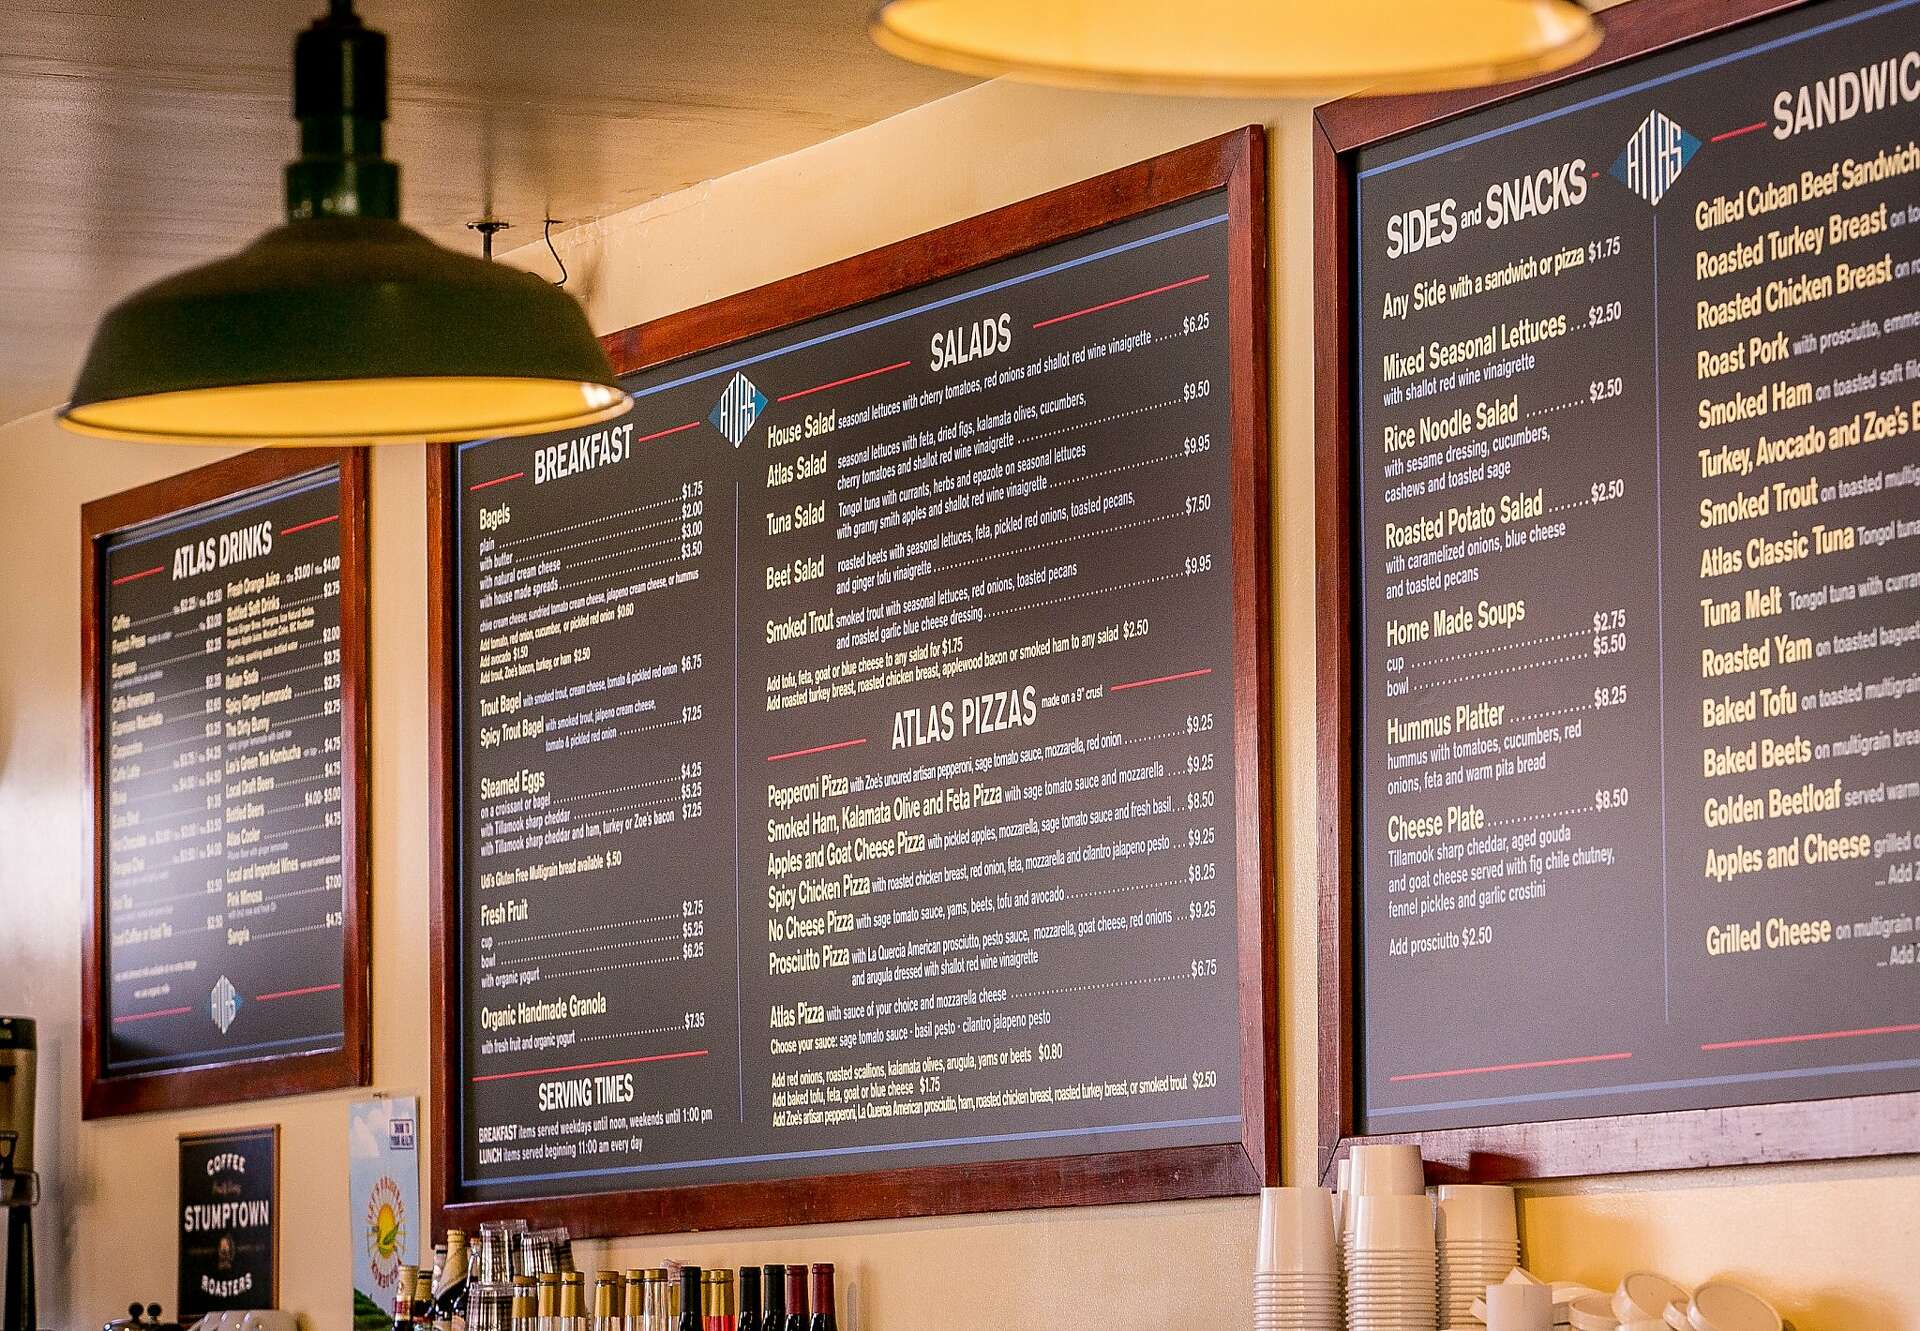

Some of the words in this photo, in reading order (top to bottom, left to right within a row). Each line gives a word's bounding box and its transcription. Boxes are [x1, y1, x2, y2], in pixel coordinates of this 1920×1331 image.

[1626, 108, 1682, 205] ATLAS
[1386, 198, 1458, 259] SIDES
[1460, 201, 1482, 230] and
[1485, 158, 1588, 230] SNACKS
[1695, 190, 1744, 231] Grilled
[1746, 182, 1798, 217] Cuban
[1801, 162, 1839, 202] Beef
[1696, 235, 1764, 281] Roasted
[1767, 225, 1825, 261] Turkey
[1828, 202, 1888, 245] Breast
[1382, 292, 1409, 321] Any
[1413, 278, 1447, 311] Side
[1449, 274, 1473, 301] with
[1474, 276, 1483, 294] a
[1484, 255, 1538, 291] sandwich
[1539, 255, 1553, 276] or
[1554, 246, 1585, 277] pizza
[1588, 235, 1621, 264] $1.75
[930, 312, 1012, 372] SALADS
[1383, 345, 1425, 382] Mixed
[1429, 326, 1496, 370] Seasonal
[1501, 314, 1567, 351] Lettuces
[1588, 300, 1622, 328] $2.50
[1697, 342, 1746, 380] Roast
[1749, 331, 1789, 367] Pork
[767, 423, 802, 449] House
[804, 408, 836, 439] Salad
[838, 406, 870, 430] seasonal
[871, 401, 901, 420] lettuces
[902, 393, 918, 411] with
[919, 389, 944, 407] cherry
[944, 379, 983, 400] tomatoes,
[983, 369, 998, 389] red
[998, 366, 1025, 385] onions
[1026, 357, 1042, 378] and
[1043, 350, 1070, 373] shallot
[1071, 345, 1086, 364] red
[1086, 342, 1107, 360] wine
[1108, 328, 1152, 354] vinaigrette
[1182, 312, 1210, 336] $6.25
[720, 371, 755, 448] ATLAS
[1384, 424, 1416, 453] Rice
[1419, 408, 1472, 445] Noodle
[1476, 394, 1518, 431] Salad
[1589, 376, 1623, 404] $2.50
[1698, 385, 1768, 430] Smoked
[1772, 381, 1813, 412] Ham
[534, 423, 634, 485] BREAKFAST
[766, 462, 794, 488] Atlas
[796, 450, 827, 480] Salad
[479, 502, 511, 531] Bagels
[766, 512, 792, 536] Tuna
[794, 499, 825, 529] Salad
[1385, 510, 1444, 550] Roasted
[1448, 502, 1496, 535] Potato
[1500, 487, 1543, 525] Salad
[1591, 478, 1624, 506] $2.50
[172, 537, 216, 581] ATLAS
[218, 520, 272, 568] DRINKS
[766, 563, 791, 590] Beet
[793, 554, 824, 584] Salad
[1700, 546, 1743, 578] Atlas
[1746, 530, 1809, 569] Classic
[1811, 524, 1855, 555] Tuna
[766, 612, 807, 644] Smoked
[808, 607, 834, 634] Trout
[1386, 619, 1430, 647] Home
[1433, 605, 1474, 638] Made
[1477, 600, 1526, 629] Soups
[1700, 598, 1741, 628] Tuna
[1745, 586, 1782, 619] Melt
[1386, 656, 1405, 675] cup
[1593, 608, 1626, 634] $2.75
[1386, 675, 1409, 697] bowl
[1593, 632, 1626, 658] $5.50
[892, 701, 954, 750] ATLAS
[962, 685, 1037, 737] PIZZAS
[1041, 693, 1060, 708] made
[1060, 693, 1070, 705] on
[1070, 692, 1076, 703] a
[1085, 684, 1103, 700] crust
[1387, 715, 1452, 745] Hummus
[1456, 702, 1505, 733] Platter
[1594, 684, 1627, 711] $8.25
[324, 736, 340, 753] $4.75
[324, 762, 340, 777] $4.75
[480, 771, 520, 800] Steamed
[521, 768, 546, 795] Eggs
[768, 776, 819, 811] Pepperoni
[821, 774, 849, 798] Pizza
[1388, 814, 1443, 843] Cheese
[1447, 804, 1484, 833] Plate
[1595, 787, 1629, 813] $8.50
[1704, 794, 1764, 828] Golden
[1768, 778, 1842, 818] Beetloaf
[1387, 844, 1435, 868] Tillamook
[1436, 841, 1465, 861] sharp
[1466, 833, 1509, 856] cheddar,
[1511, 827, 1537, 851] aged
[1538, 823, 1571, 848] gouda
[481, 902, 506, 927] Fresh
[507, 898, 528, 922] Fruit
[768, 883, 797, 913] Spicy
[798, 877, 841, 905] Chicken
[842, 873, 870, 898] Pizza
[768, 918, 784, 942] No
[785, 915, 825, 940] Cheese
[826, 909, 854, 934] Pizza
[855, 912, 872, 929] with
[873, 913, 892, 929] sage
[892, 906, 920, 924] tomato
[920, 905, 946, 921] sauce,
[946, 902, 969, 920] yams,
[970, 896, 995, 914] beets,
[996, 892, 1013, 910] tofu
[1014, 890, 1029, 908] and
[1031, 885, 1065, 905] avocado
[1188, 862, 1216, 884] $8.25
[1389, 936, 1408, 957] Add
[1410, 931, 1460, 957] prosciutto
[1462, 924, 1493, 949] $2.50
[1706, 920, 1761, 956] Grilled
[1765, 918, 1832, 950] Cheese
[481, 1004, 517, 1031] Organic
[518, 996, 568, 1024] Handmade
[569, 991, 607, 1018] Granola
[538, 1077, 592, 1112] SERVING
[594, 1072, 634, 1104] TIMES
[207, 1153, 246, 1176] COFFEE
[478, 1146, 503, 1165] LUNCH
[503, 1148, 521, 1162] items
[522, 1144, 544, 1160] served
[544, 1141, 577, 1161] beginning
[578, 1138, 598, 1155] 11:00
[598, 1140, 610, 1153] am
[610, 1139, 629, 1154] every
[630, 1134, 643, 1153] day
[184, 1200, 269, 1232] STUMPTOWN
[201, 1272, 252, 1298] ROASTERS
